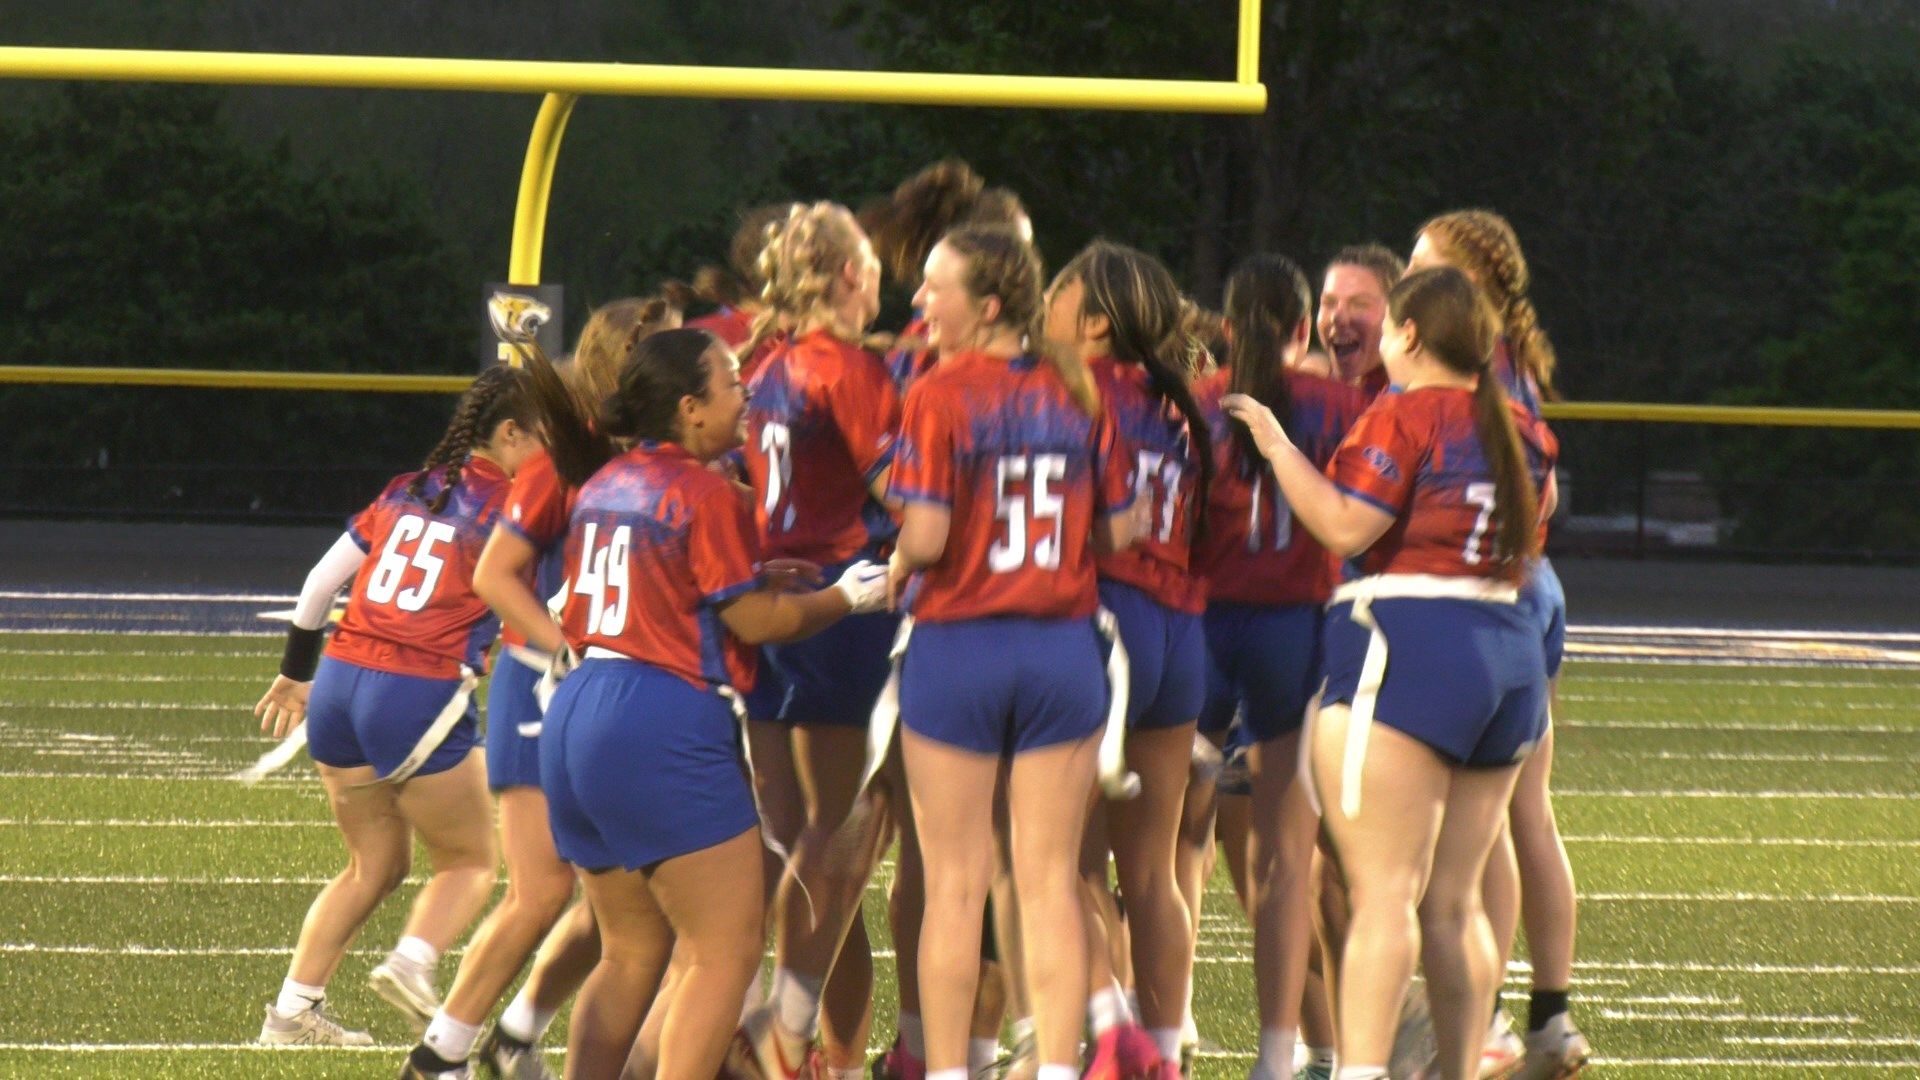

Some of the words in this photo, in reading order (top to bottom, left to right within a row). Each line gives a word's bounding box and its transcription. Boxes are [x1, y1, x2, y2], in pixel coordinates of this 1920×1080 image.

[366, 514, 455, 612] 65
[987, 454, 1067, 573] 55
[573, 522, 631, 637] 49
